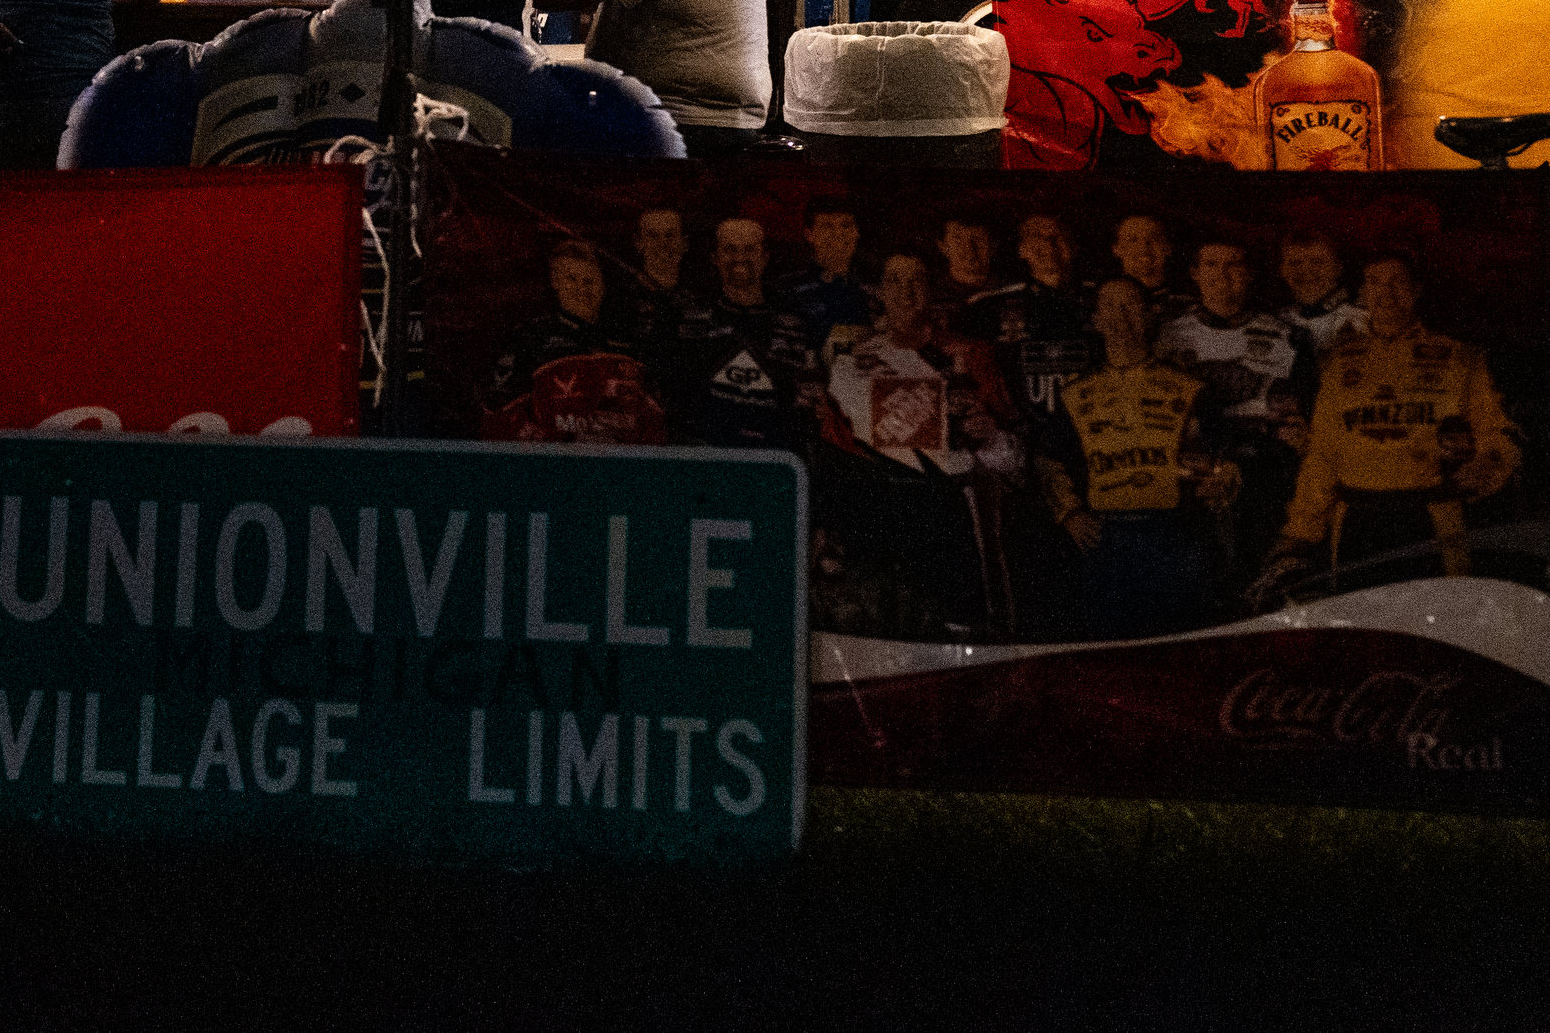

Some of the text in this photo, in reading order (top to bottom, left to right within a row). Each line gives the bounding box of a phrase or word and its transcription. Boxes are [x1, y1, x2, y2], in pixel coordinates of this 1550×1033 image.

[1276, 111, 1364, 144] FIREBALL
[153, 632, 623, 713] MICHIGAN
[466, 707, 768, 819] LIMITS
[1406, 730, 1506, 773] Real
